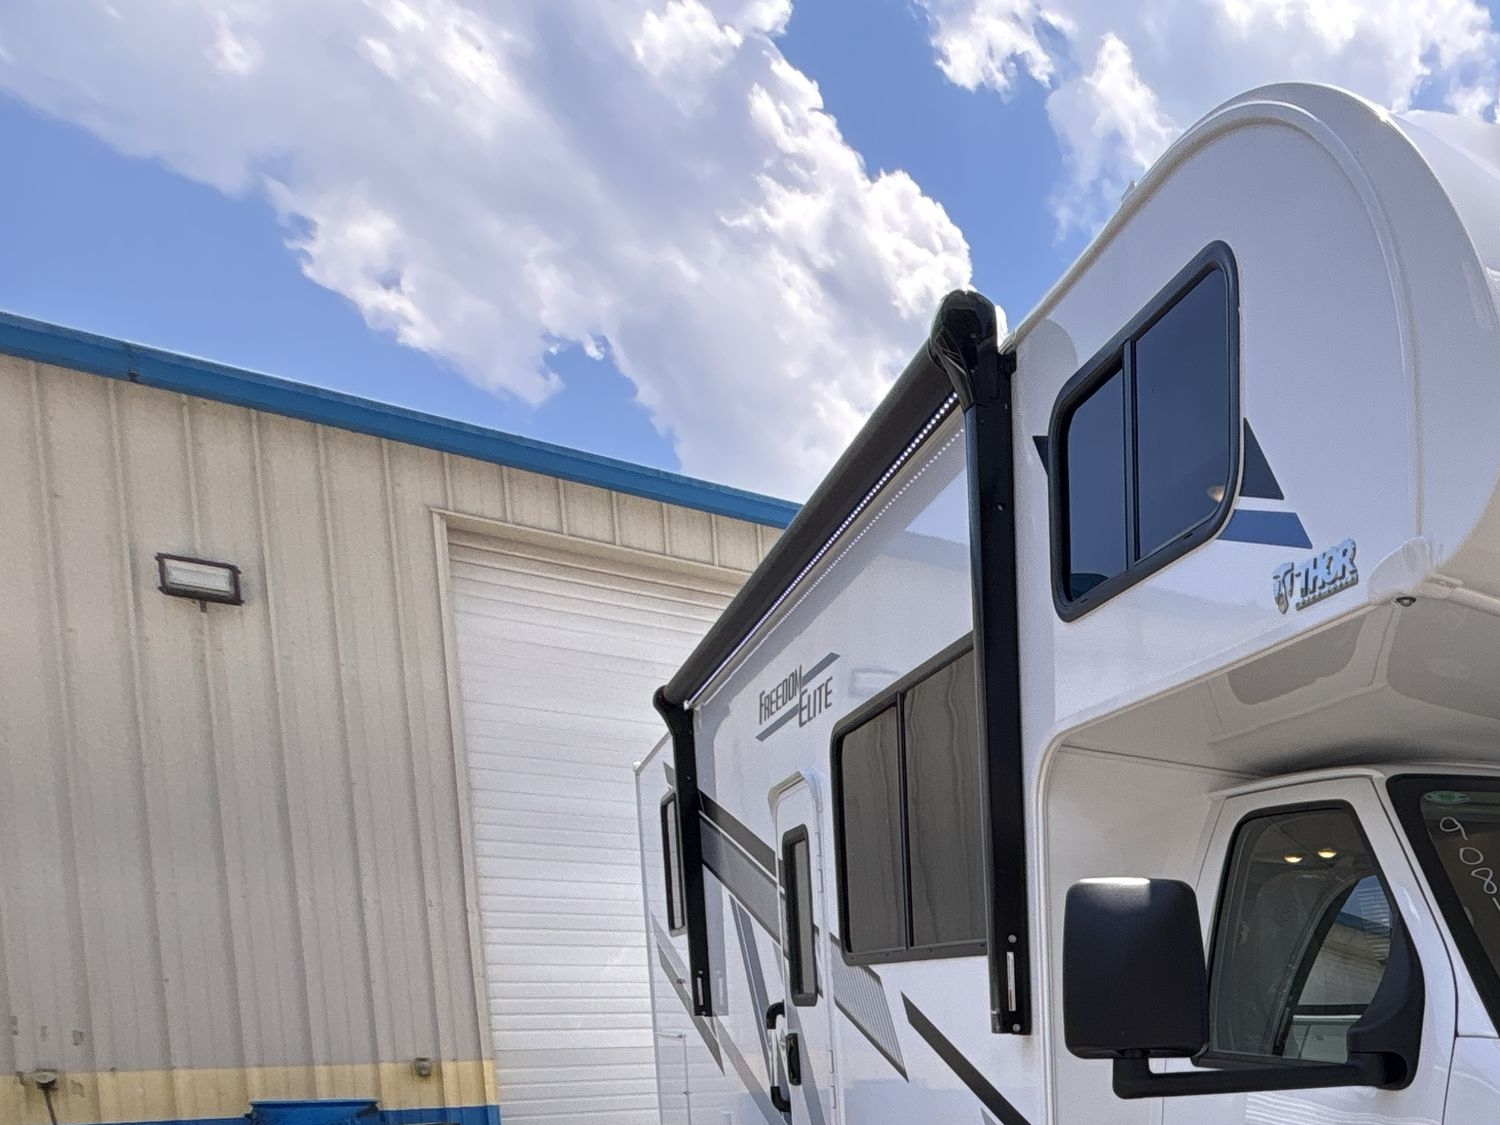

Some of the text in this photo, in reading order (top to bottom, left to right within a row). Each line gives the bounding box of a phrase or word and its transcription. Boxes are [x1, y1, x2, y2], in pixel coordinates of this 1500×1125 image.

[1296, 539, 1358, 598] THOR
[759, 664, 802, 726] FREEDOM
[799, 676, 833, 728] ELITE
